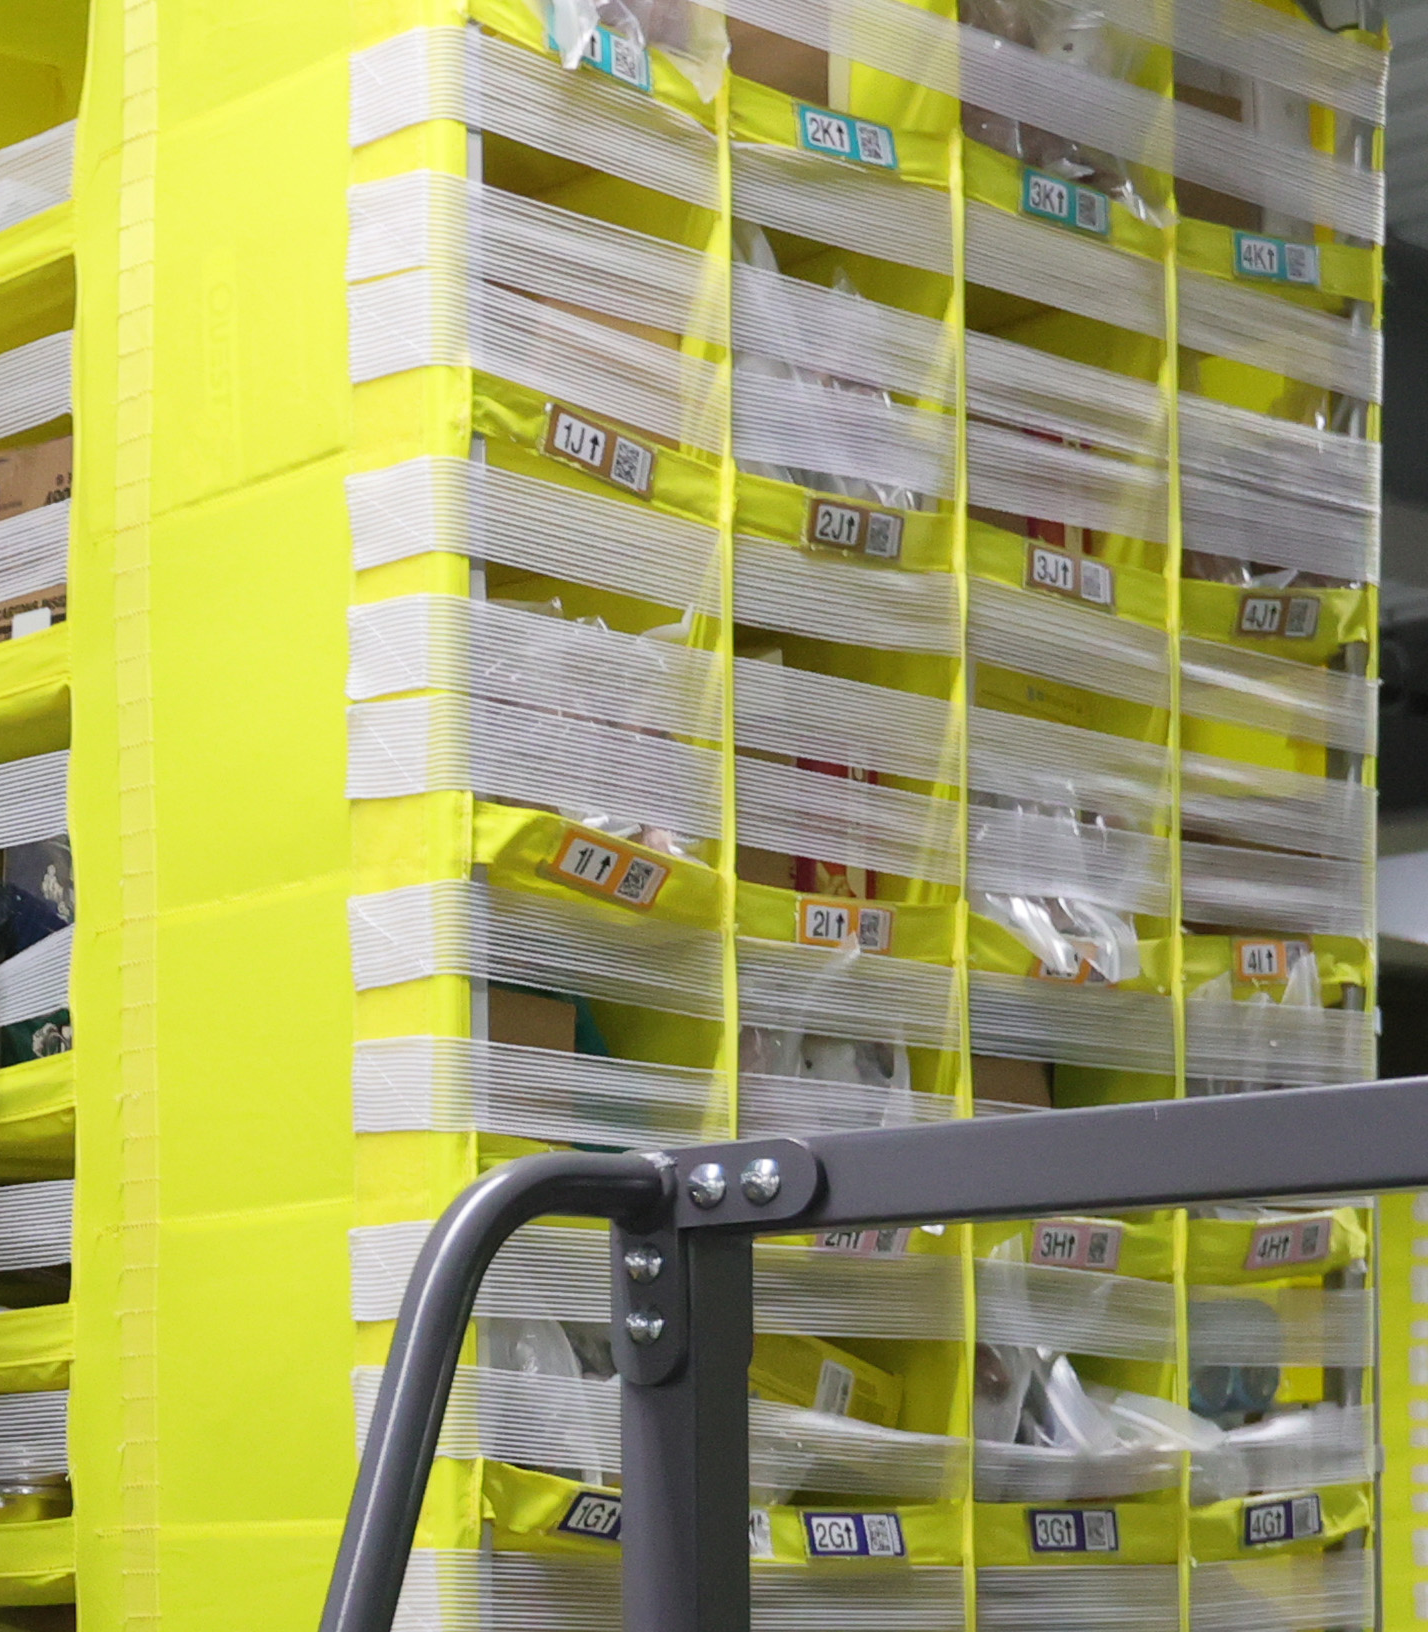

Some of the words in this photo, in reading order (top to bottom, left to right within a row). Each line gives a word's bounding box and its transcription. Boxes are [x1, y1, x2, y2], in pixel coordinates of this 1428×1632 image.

[810, 117, 835, 146] 2K
[1030, 180, 1057, 209] 3K
[1242, 239, 1268, 269] 4K
[563, 417, 582, 450] 1J
[819, 508, 843, 533] 2J
[1037, 553, 1058, 580] 3J
[1246, 602, 1269, 629] 4J
[812, 910, 829, 938] 2I
[1041, 1233, 1066, 1258] 3H
[1256, 1235, 1280, 1260] 4H
[578, 1501, 601, 1528] 1G
[1251, 1513, 1274, 1538] 4G
[817, 1521, 843, 1550] 2G
[1037, 1516, 1063, 1545] 3G
